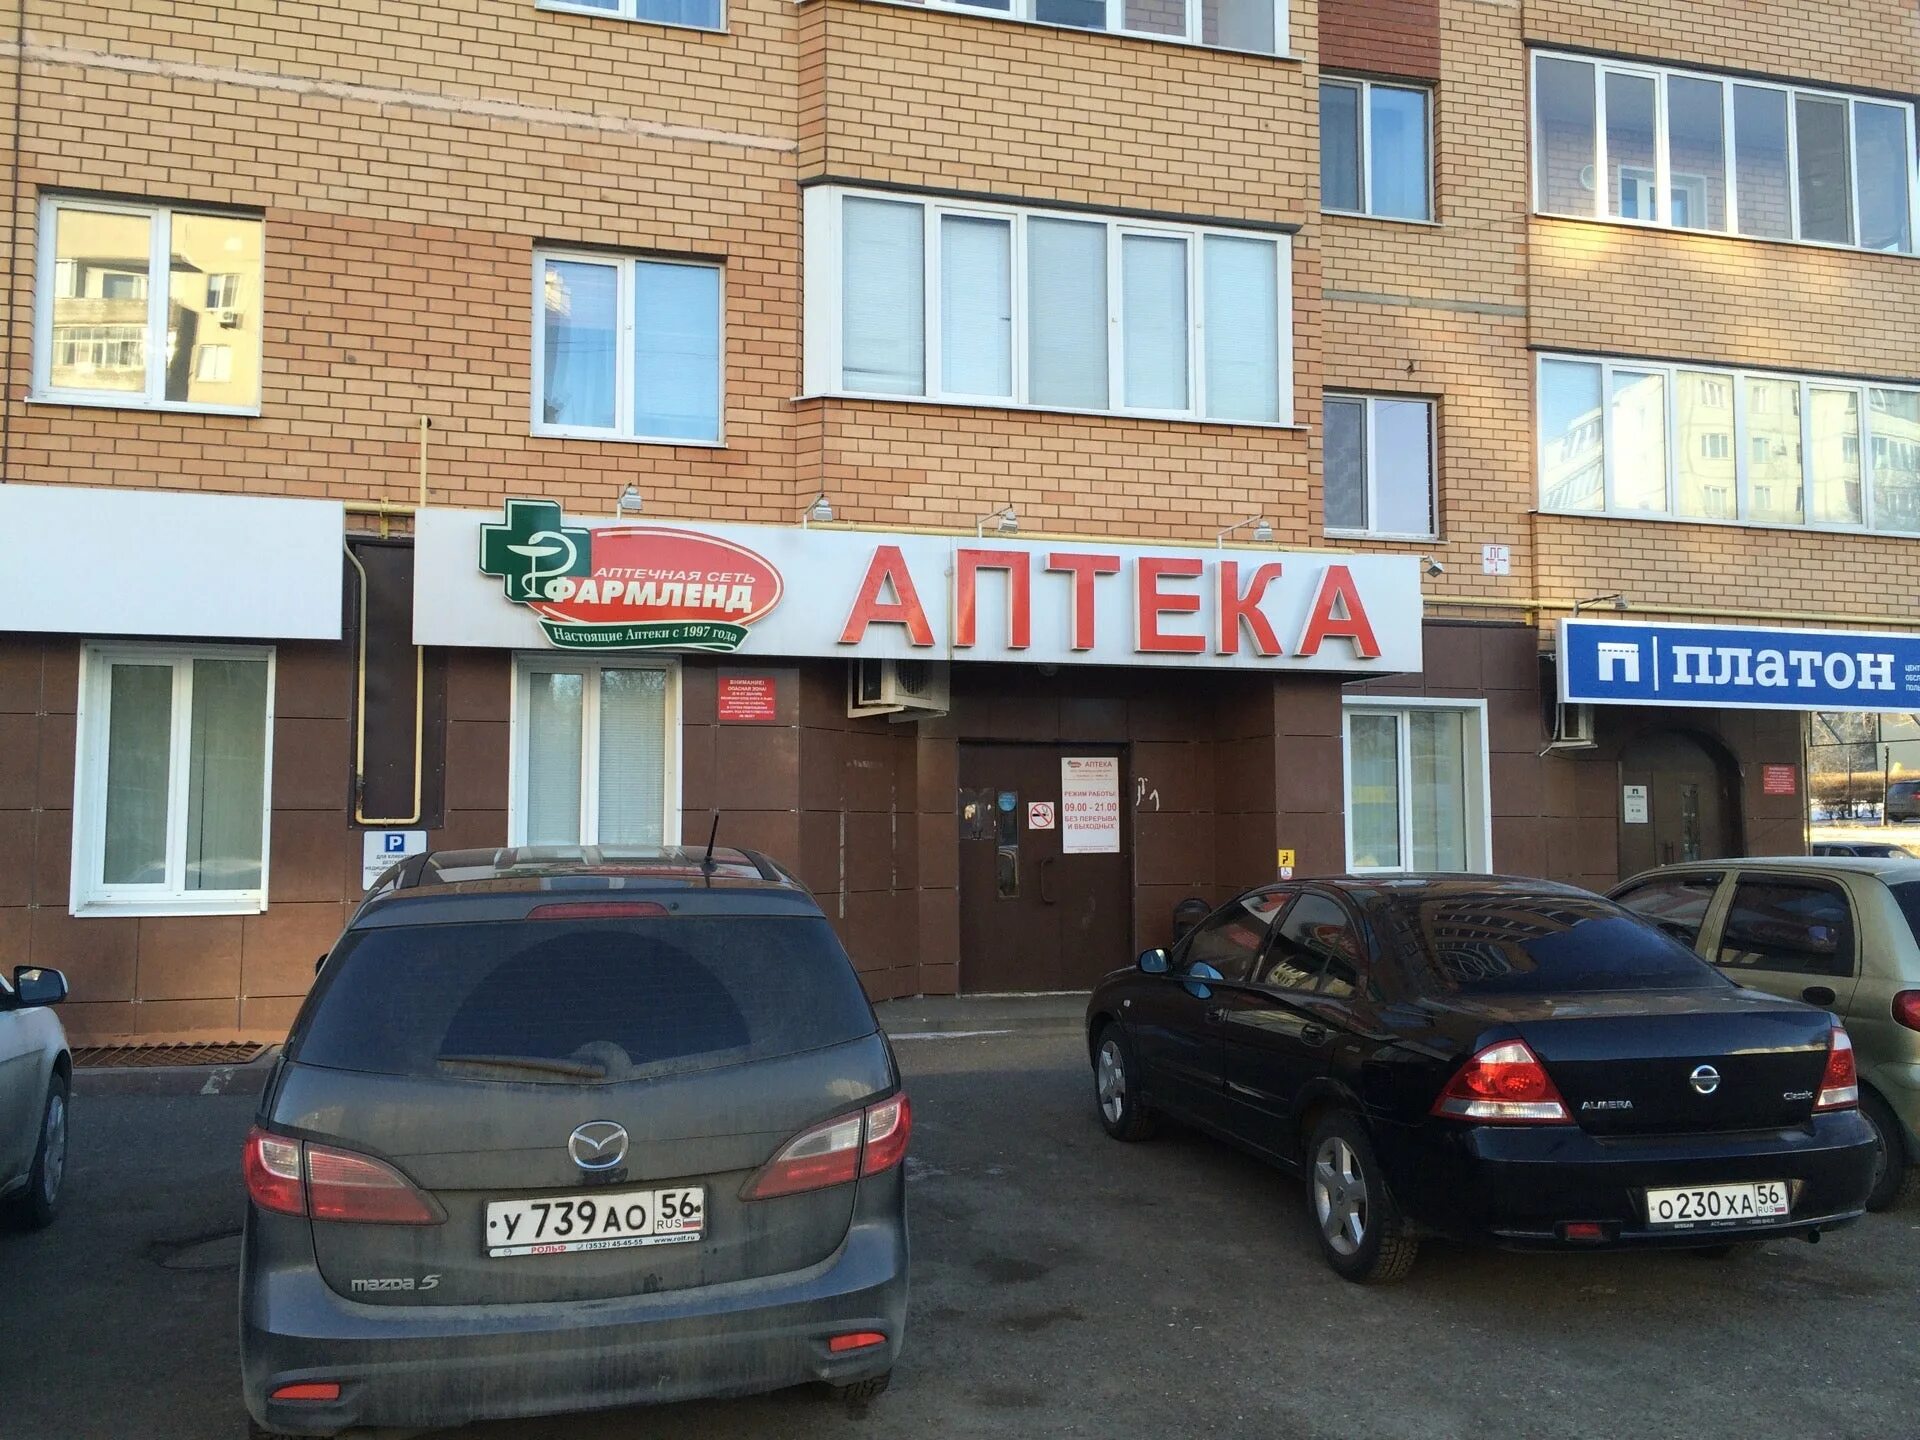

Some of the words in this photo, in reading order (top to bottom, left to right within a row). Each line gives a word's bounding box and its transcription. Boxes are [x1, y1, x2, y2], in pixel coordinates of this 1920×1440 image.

[594, 567, 701, 581] АПТЕЧНАЯ
[707, 571, 756, 584] СЕТЬ
[544, 577, 752, 614] ФАРМЛЕНД
[838, 545, 1382, 658] АПТЕКА
[553, 627, 622, 643] Настоящие
[626, 628, 669, 641] Аптеки
[672, 630, 679, 638] с
[683, 625, 709, 638] 1997
[712, 629, 737, 642] года
[1064, 802, 1087, 812] 09.00
[1094, 802, 1117, 812] 21.00
[1581, 1100, 1633, 1110] ALMERA
[1757, 1185, 1779, 1205] 56
[661, 1192, 694, 1219] 56
[1758, 1205, 1774, 1214] RUS
[656, 1217, 682, 1229] RUS
[531, 1244, 567, 1254] РОЛЬФ
